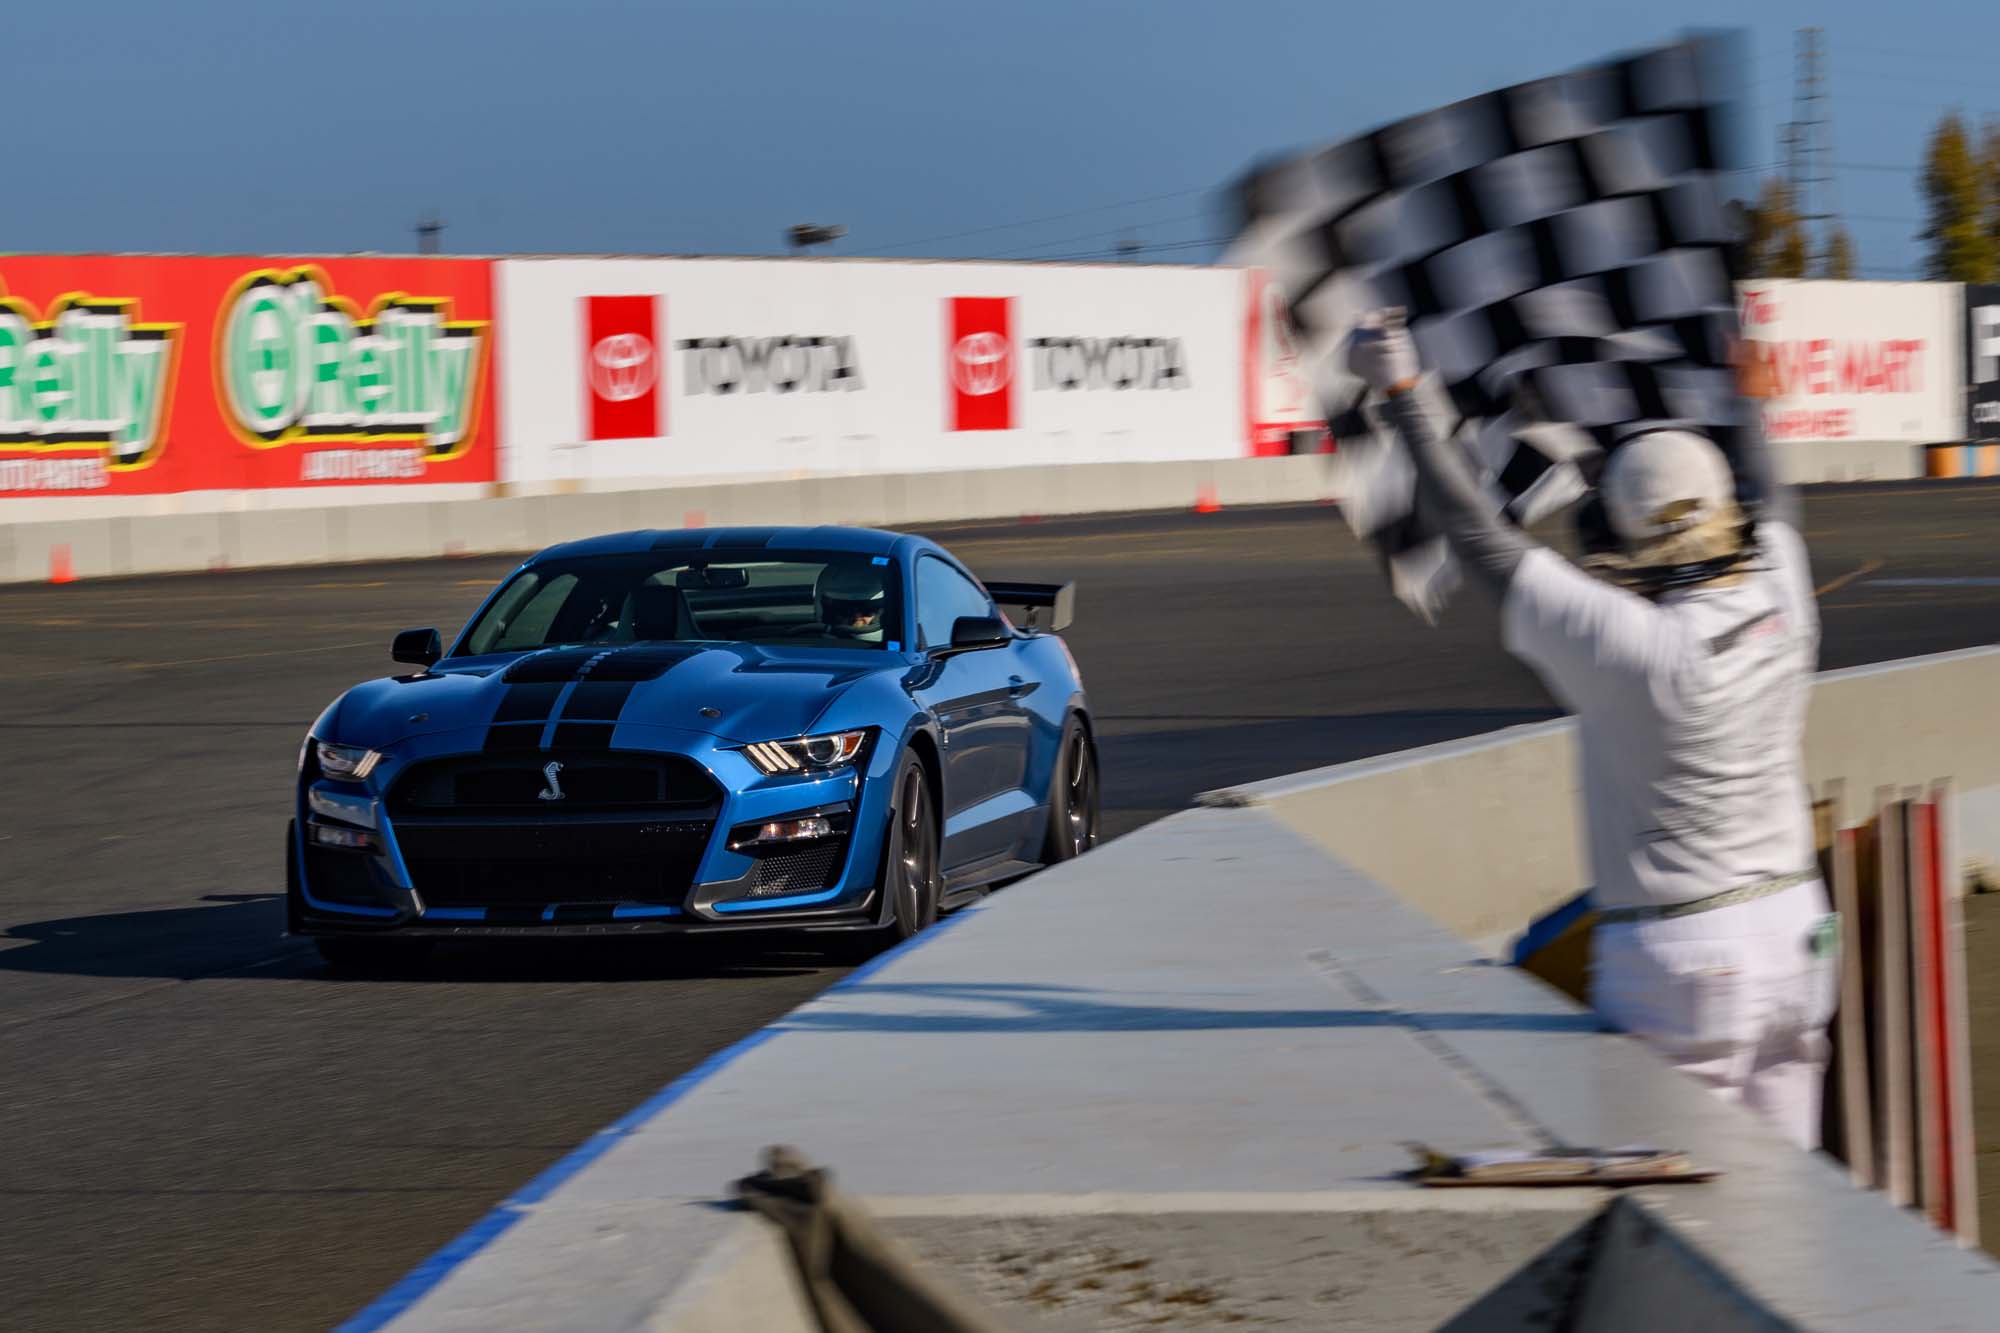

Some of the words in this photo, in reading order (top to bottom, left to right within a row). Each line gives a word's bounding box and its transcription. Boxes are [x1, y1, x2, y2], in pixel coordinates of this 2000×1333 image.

[215, 270, 484, 456] O'Reilly
[674, 336, 866, 394] TOYOTA
[1027, 337, 1191, 391] TOYOTA
